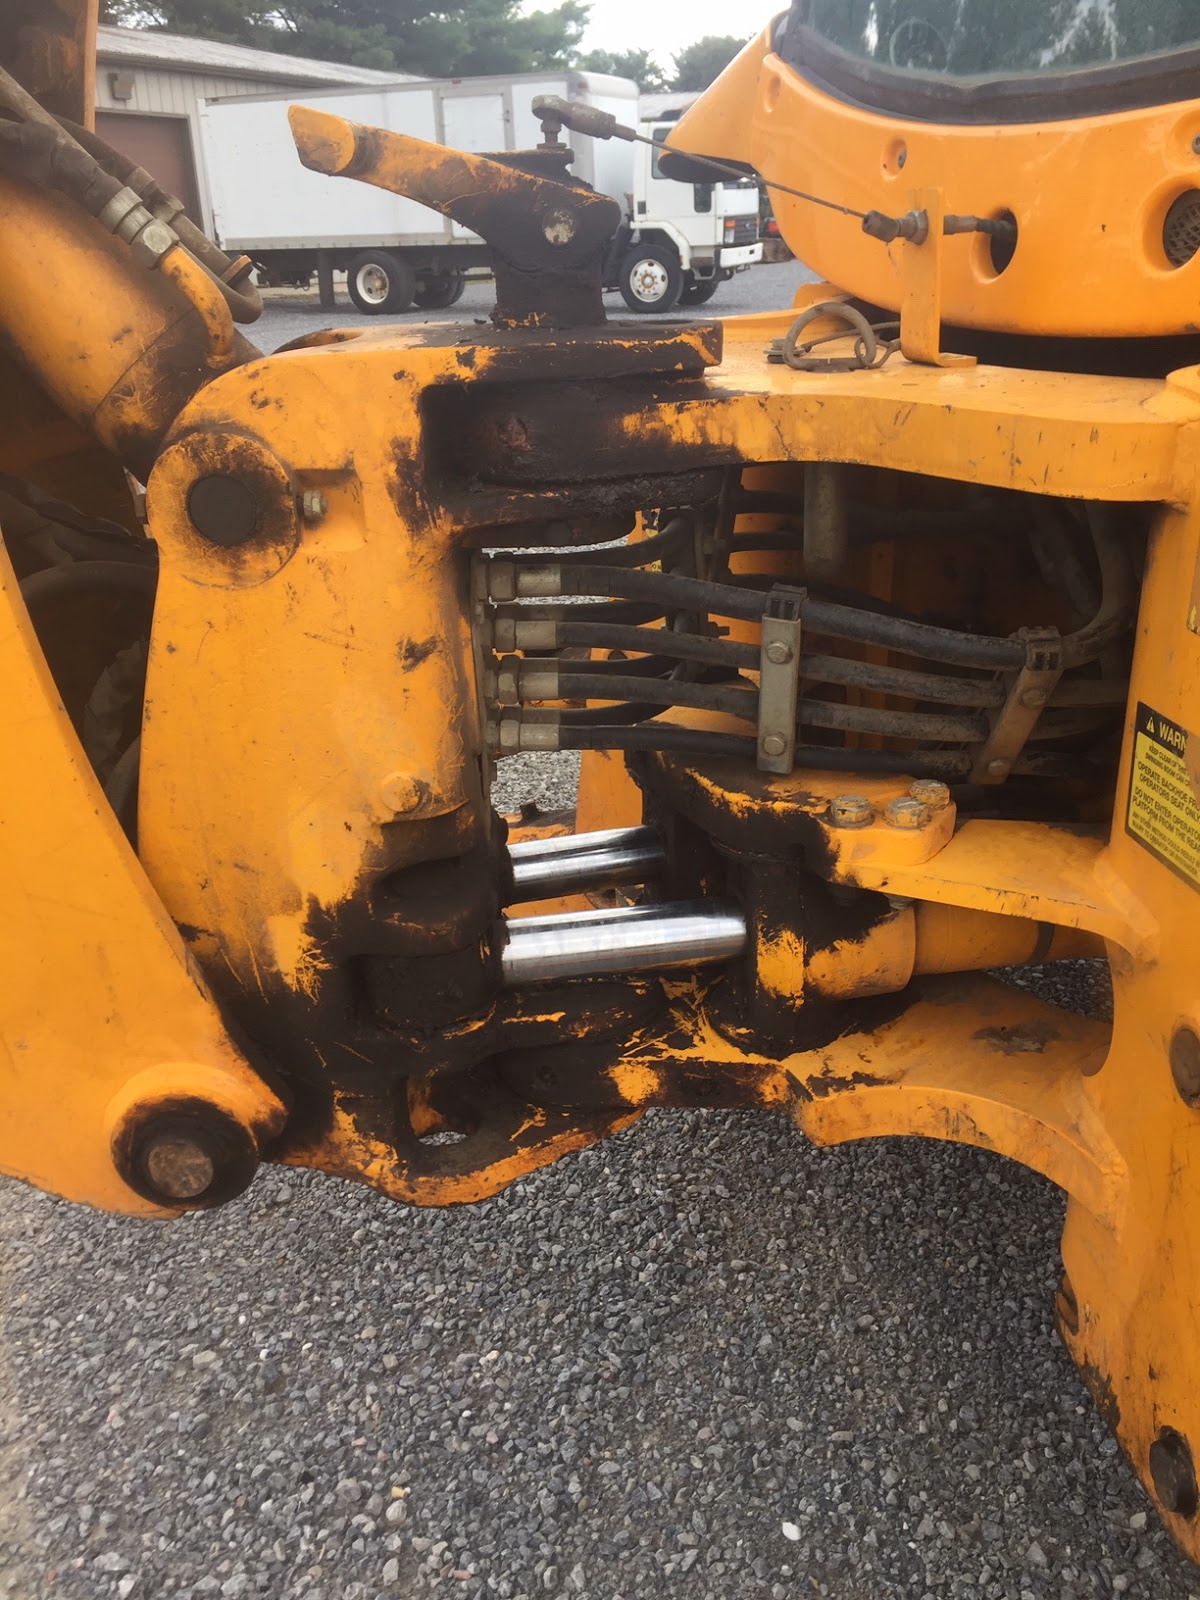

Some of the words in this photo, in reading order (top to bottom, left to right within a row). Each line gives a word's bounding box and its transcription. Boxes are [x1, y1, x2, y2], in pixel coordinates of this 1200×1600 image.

[1145, 752, 1164, 769] SWINGING
[1164, 765, 1175, 777] BOOM
[1176, 773, 1184, 783] CAN
[1149, 746, 1158, 755] KEEP
[1159, 752, 1171, 764] CLEAR
[1138, 761, 1161, 783] OPERATE
[1162, 778, 1188, 802] BACKHOE
[1139, 774, 1170, 801] OPERATORS
[1171, 796, 1184, 811] SEAT
[1133, 796, 1158, 820] PLATFORM
[1159, 816, 1175, 833] FROM
[1175, 827, 1186, 842] THE
[1135, 787, 1142, 798] DO
[1143, 792, 1154, 805] NOT
[1155, 802, 1172, 819] ENTER
[1132, 820, 1144, 831] INJURY
[1144, 829, 1149, 837] TO
[1150, 834, 1169, 852] OPERATOR
[1140, 816, 1152, 828] OTHER
[1152, 826, 1168, 842] METHOD
